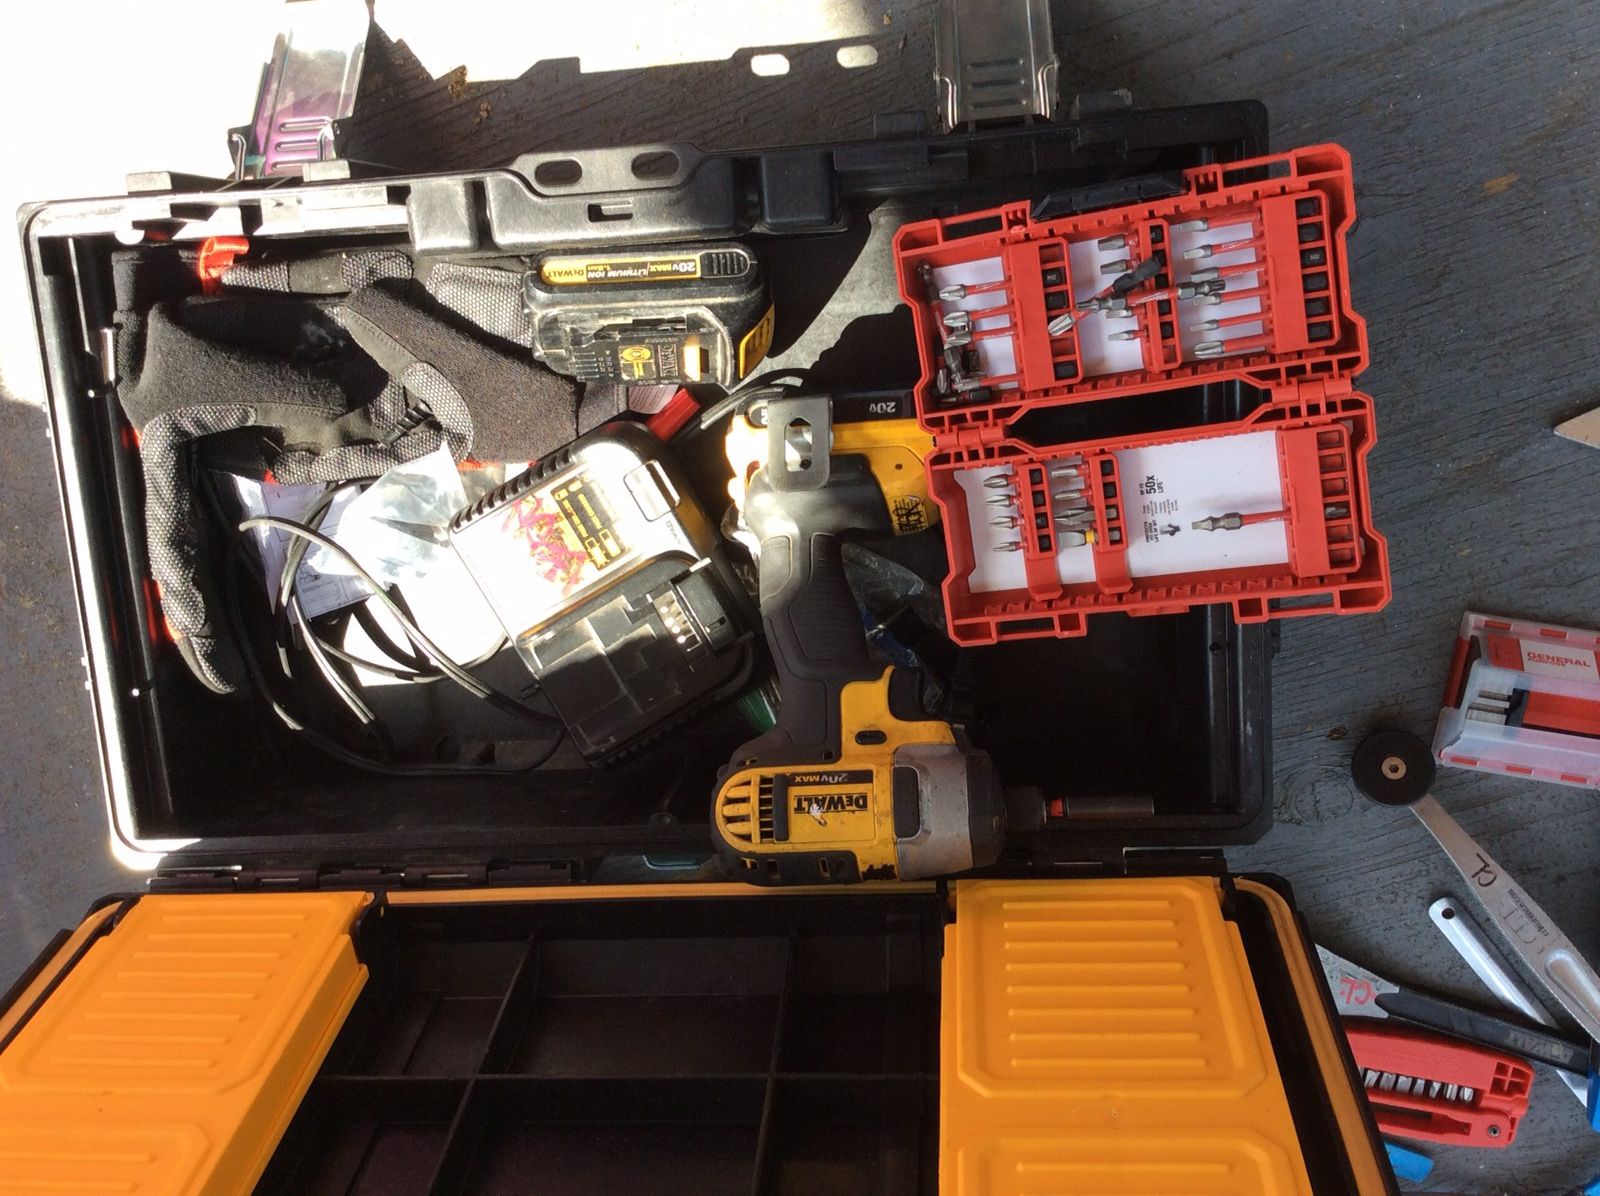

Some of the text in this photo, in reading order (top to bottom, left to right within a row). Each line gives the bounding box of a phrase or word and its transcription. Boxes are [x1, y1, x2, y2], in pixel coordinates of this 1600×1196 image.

[649, 262, 672, 272] MAX
[588, 269, 606, 279] ION
[1526, 652, 1592, 668] GENERAL
[794, 774, 820, 783] MAX
